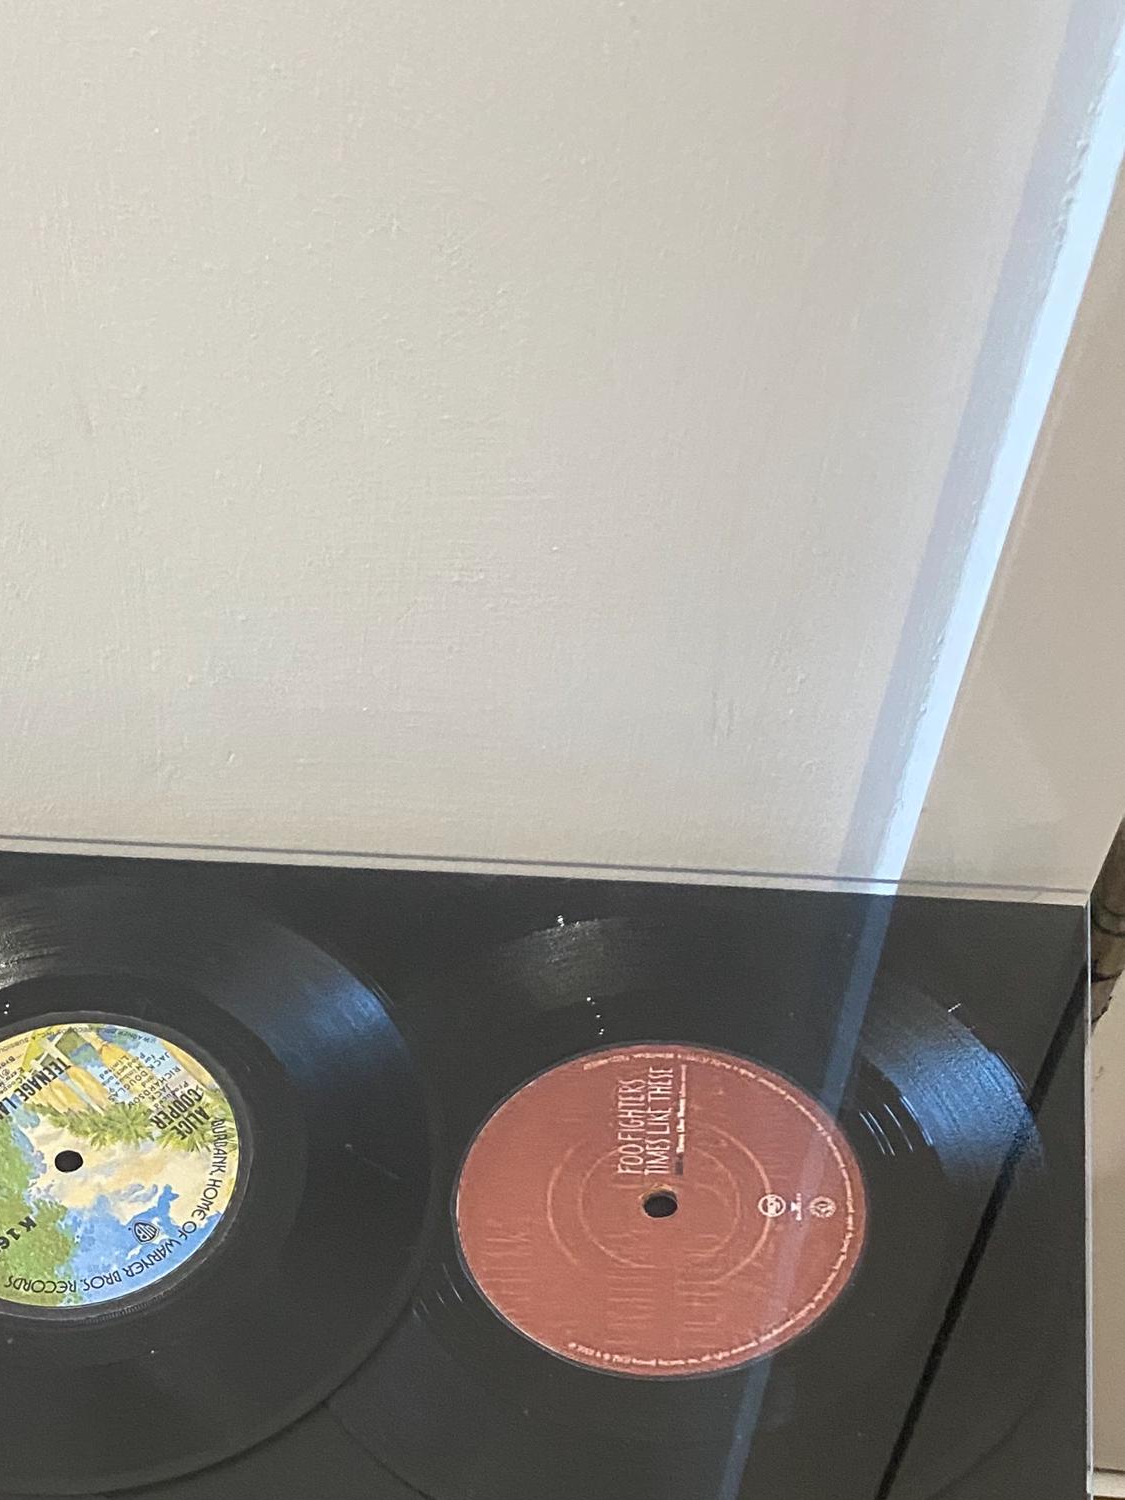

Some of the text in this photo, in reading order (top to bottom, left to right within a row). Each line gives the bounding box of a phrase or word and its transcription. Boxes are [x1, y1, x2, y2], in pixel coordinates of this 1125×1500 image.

[13, 1055, 71, 1102] TEENAGE
[98, 1055, 129, 1079] Limited
[107, 1052, 170, 1102] JACK DOUGLAS
[126, 1066, 180, 1108] RICHARDSON
[148, 1083, 171, 1102] JACK
[148, 1087, 203, 1131] COOPER
[169, 1106, 211, 1140] ALICE
[617, 1078, 644, 1174] FOO FIGHTERS
[644, 1066, 673, 1175] TIMES LIKE THESE
[190, 1178, 219, 1219] HOME
[122, 1237, 178, 1276] WARNER
[3, 1275, 76, 1294] RECORDS
[80, 1271, 123, 1291] BROS.
